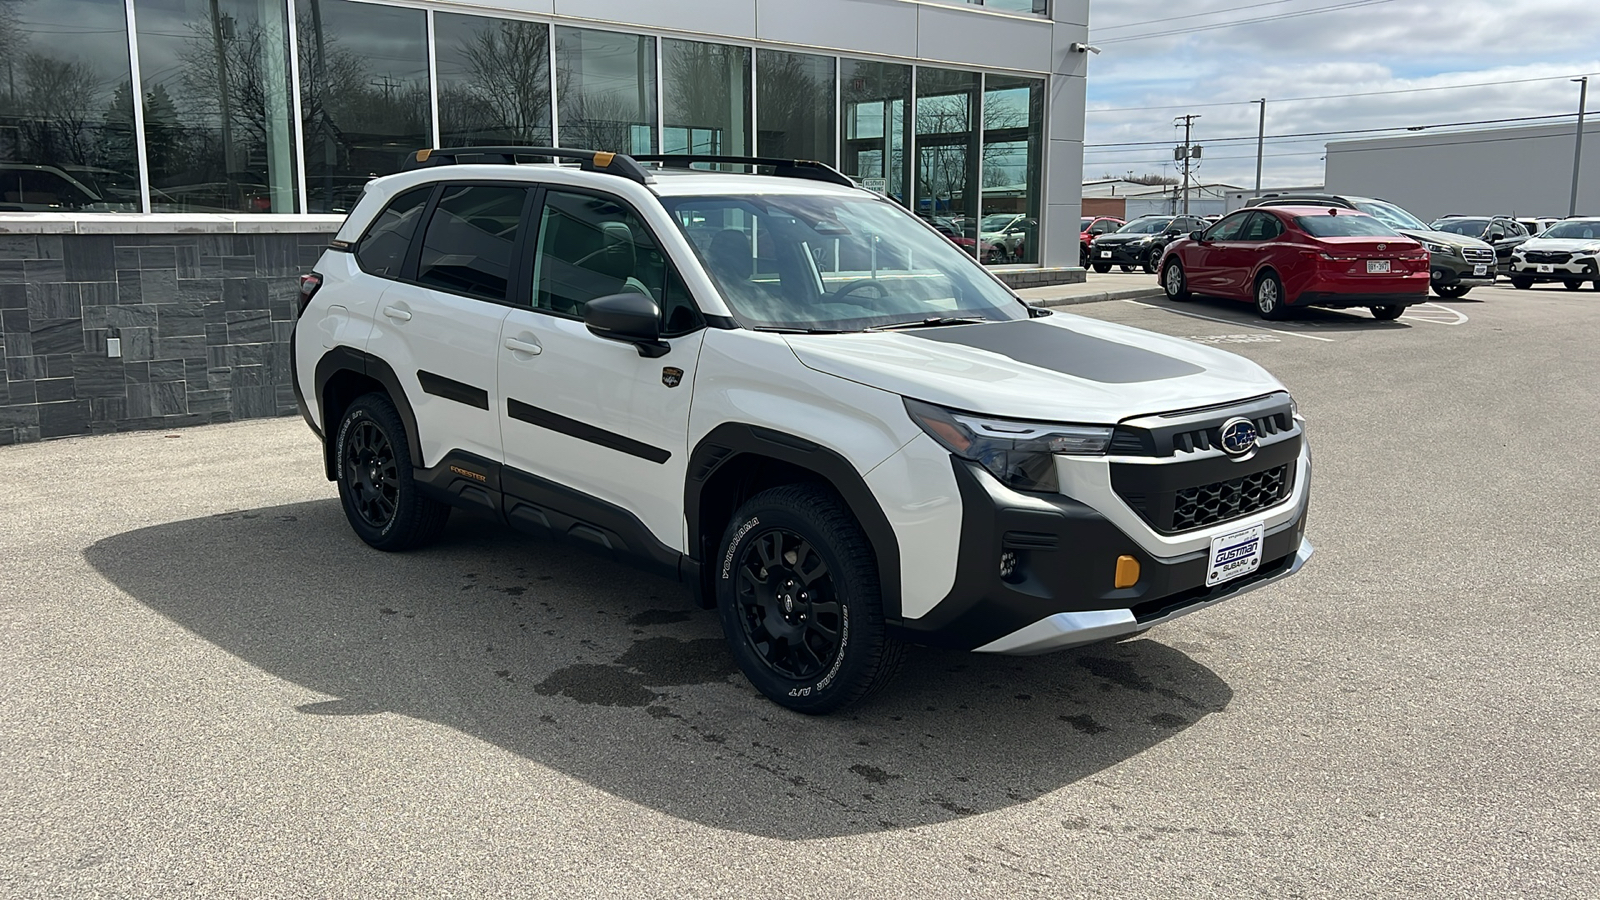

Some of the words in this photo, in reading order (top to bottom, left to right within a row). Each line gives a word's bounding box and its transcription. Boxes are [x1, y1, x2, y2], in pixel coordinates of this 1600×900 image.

[450, 465, 486, 482] FORESTER
[722, 516, 760, 579] YOKOHAMA
[1222, 558, 1249, 572] SUBARU
[816, 604, 849, 691] GEOLANDAR
[788, 686, 812, 697] A/T
